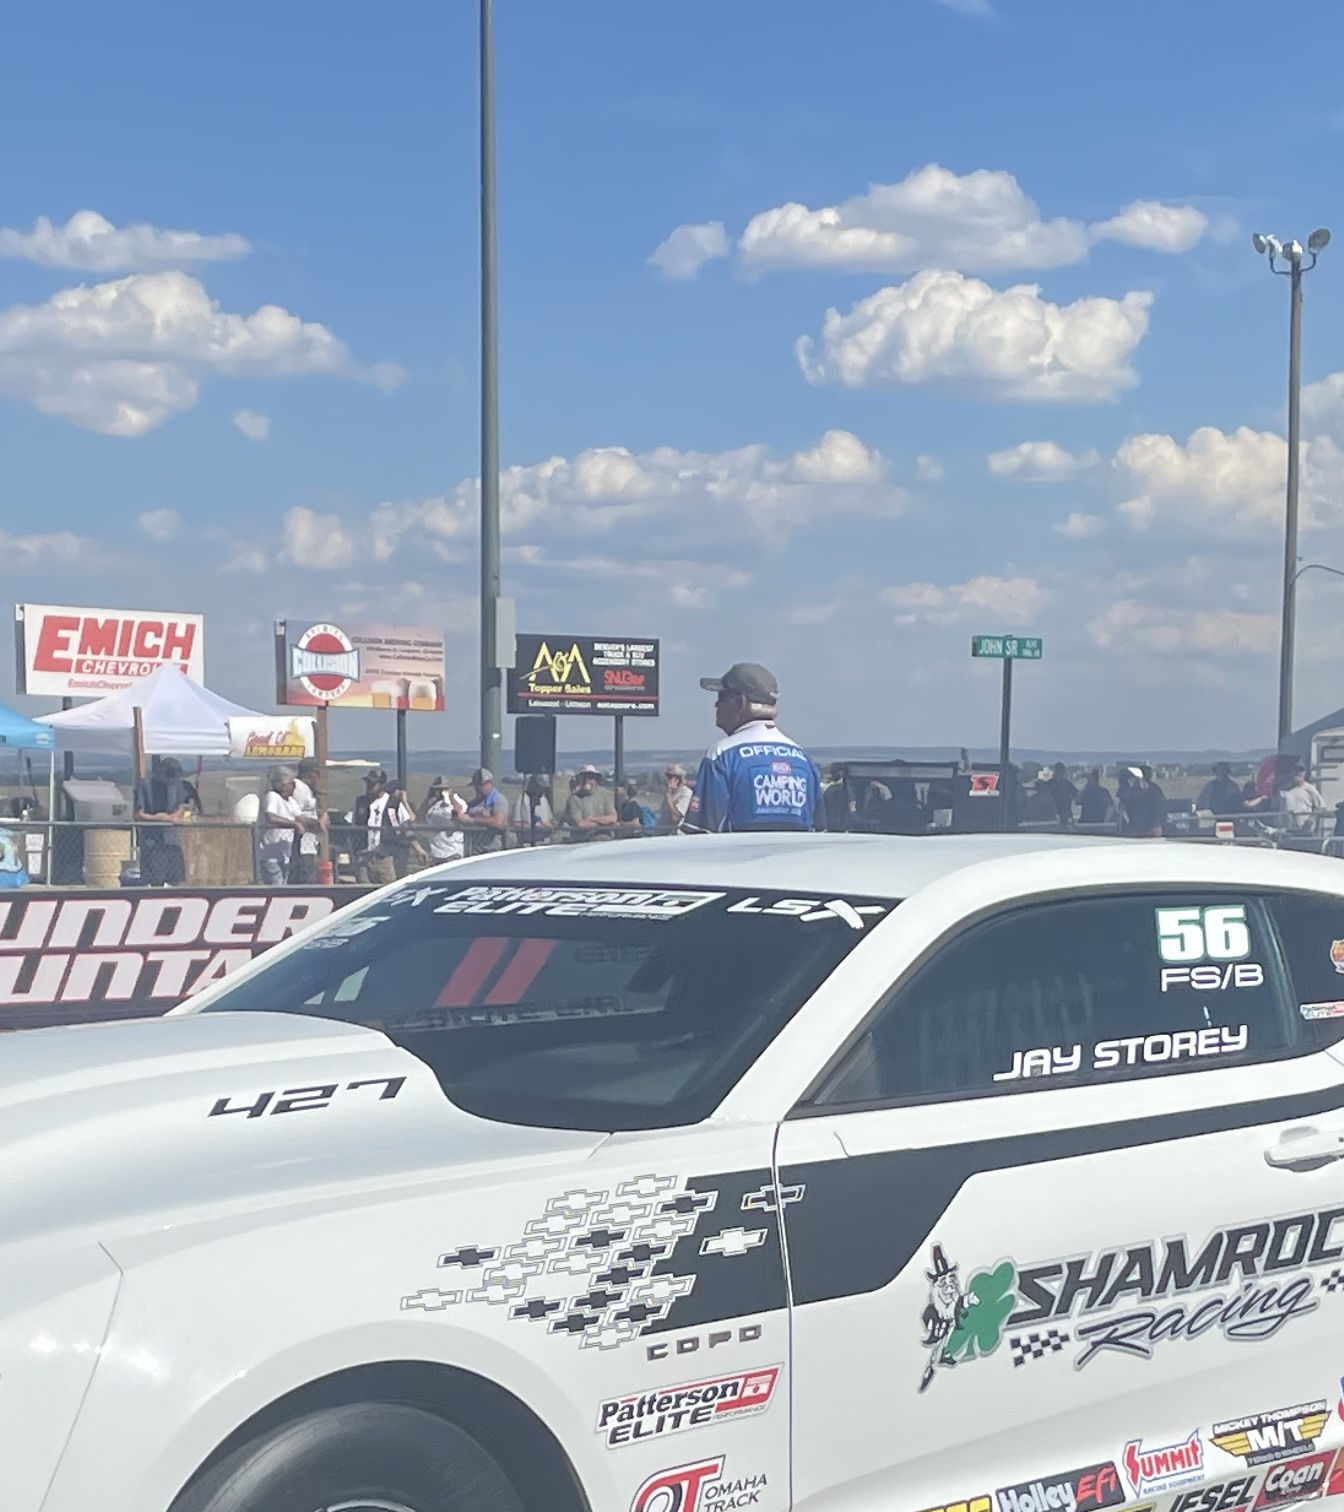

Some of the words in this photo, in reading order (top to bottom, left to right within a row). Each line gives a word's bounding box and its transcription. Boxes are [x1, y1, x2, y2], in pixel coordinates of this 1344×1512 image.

[33, 614, 197, 673] EMICH
[978, 638, 1003, 654] JOHN
[739, 745, 808, 762] OFFICIAL
[753, 774, 807, 792] CAMPING
[755, 789, 807, 808] WORLD
[433, 901, 587, 917] ELITE
[444, 886, 657, 906] Patterson
[727, 896, 886, 930] LSX
[1155, 904, 1252, 963] 56
[1160, 963, 1264, 992] FS/B
[992, 1045, 1081, 1082] JAY
[1093, 1024, 1249, 1069] STOREY
[207, 1075, 407, 1120] 427
[1075, 1275, 1318, 1370] Racing
[646, 1324, 762, 1361] COPO
[598, 1380, 740, 1428] Patterson
[1213, 1415, 1259, 1435] MICKEY
[1260, 1401, 1325, 1423] THOMPSON
[609, 1403, 716, 1445] ELITE
[1246, 1418, 1305, 1452] M/T
[1125, 1438, 1200, 1486] SUMMIT
[1264, 1461, 1324, 1493] Coan
[704, 1473, 768, 1500] OMAHA
